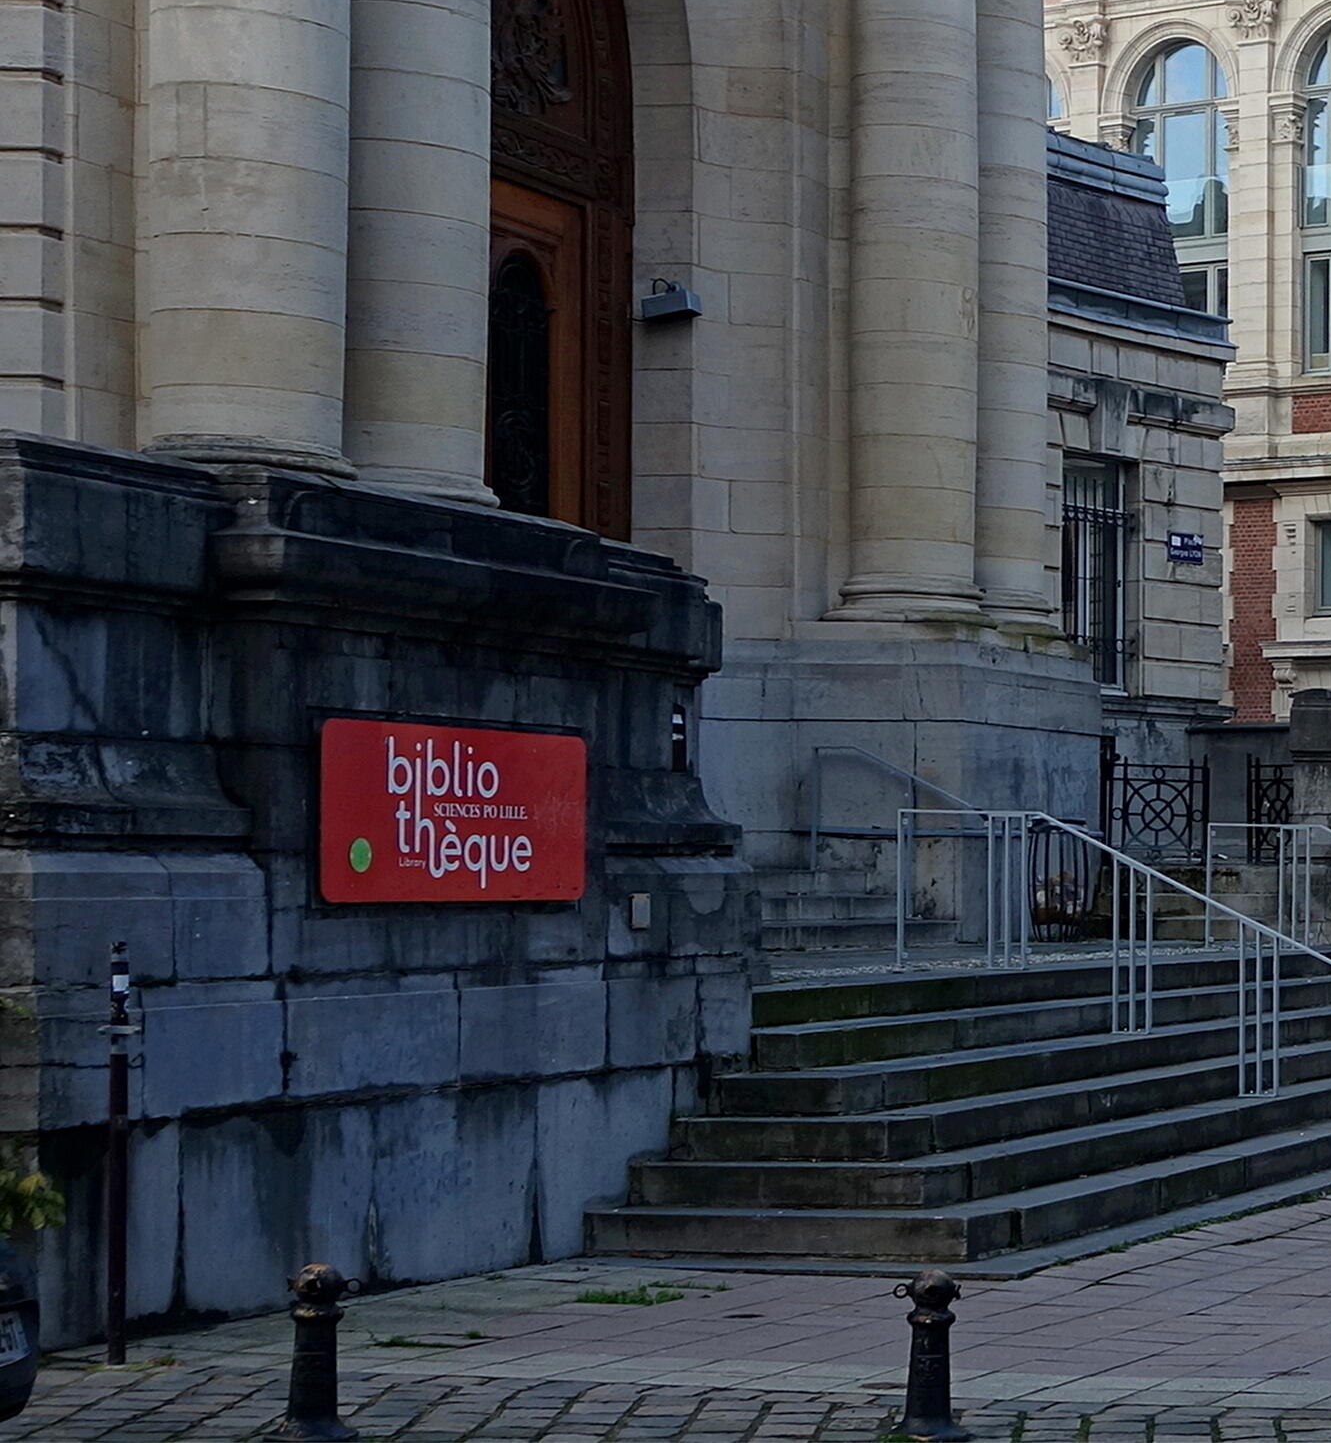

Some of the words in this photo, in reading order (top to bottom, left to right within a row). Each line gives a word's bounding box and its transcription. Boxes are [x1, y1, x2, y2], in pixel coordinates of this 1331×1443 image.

[387, 736, 500, 799] biblio
[434, 802, 480, 818] SCIENCES
[483, 805, 498, 819] PO
[395, 800, 533, 889] thèque
[399, 857, 427, 869] Library
